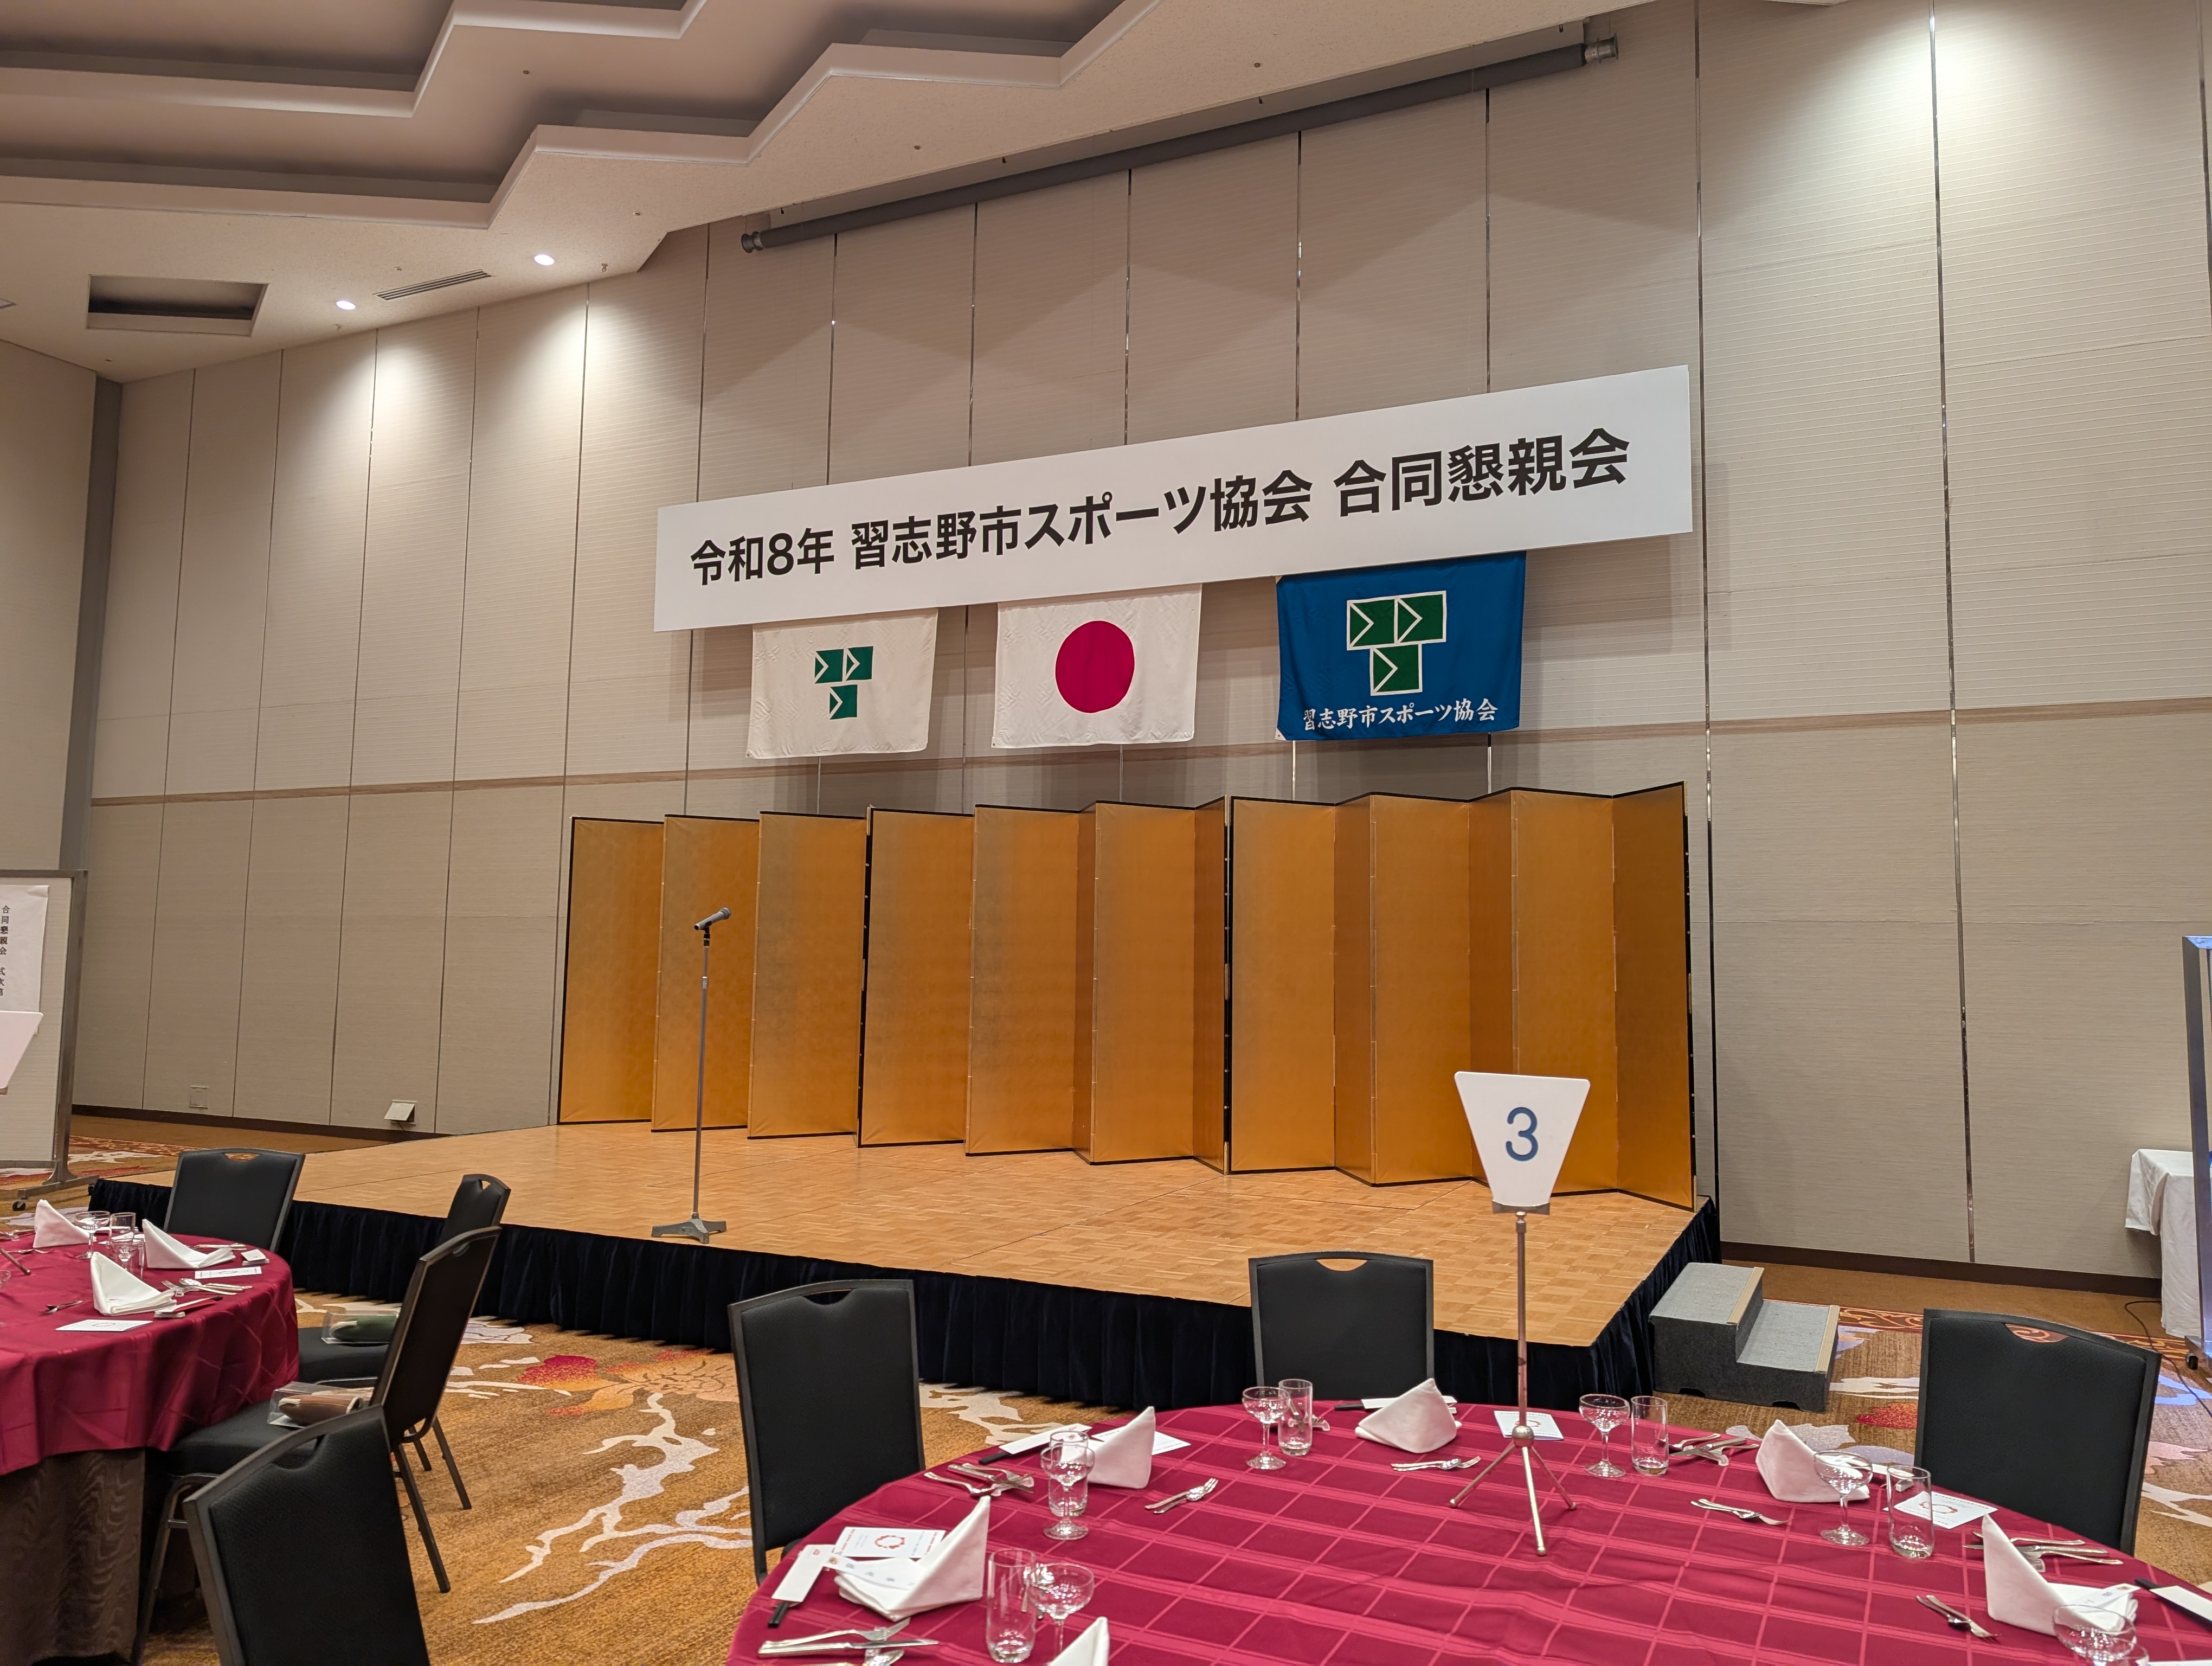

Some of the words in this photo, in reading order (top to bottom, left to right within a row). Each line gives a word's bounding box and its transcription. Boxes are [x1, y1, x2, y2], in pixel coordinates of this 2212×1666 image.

[691, 528, 834, 586] 令和8年
[852, 470, 1313, 570] 習志野市スポーツ協会
[1333, 427, 1630, 518] 合同懇親会
[1303, 697, 1499, 731] 習志野市スポーツ協会
[1506, 1106, 1538, 1161] 3
